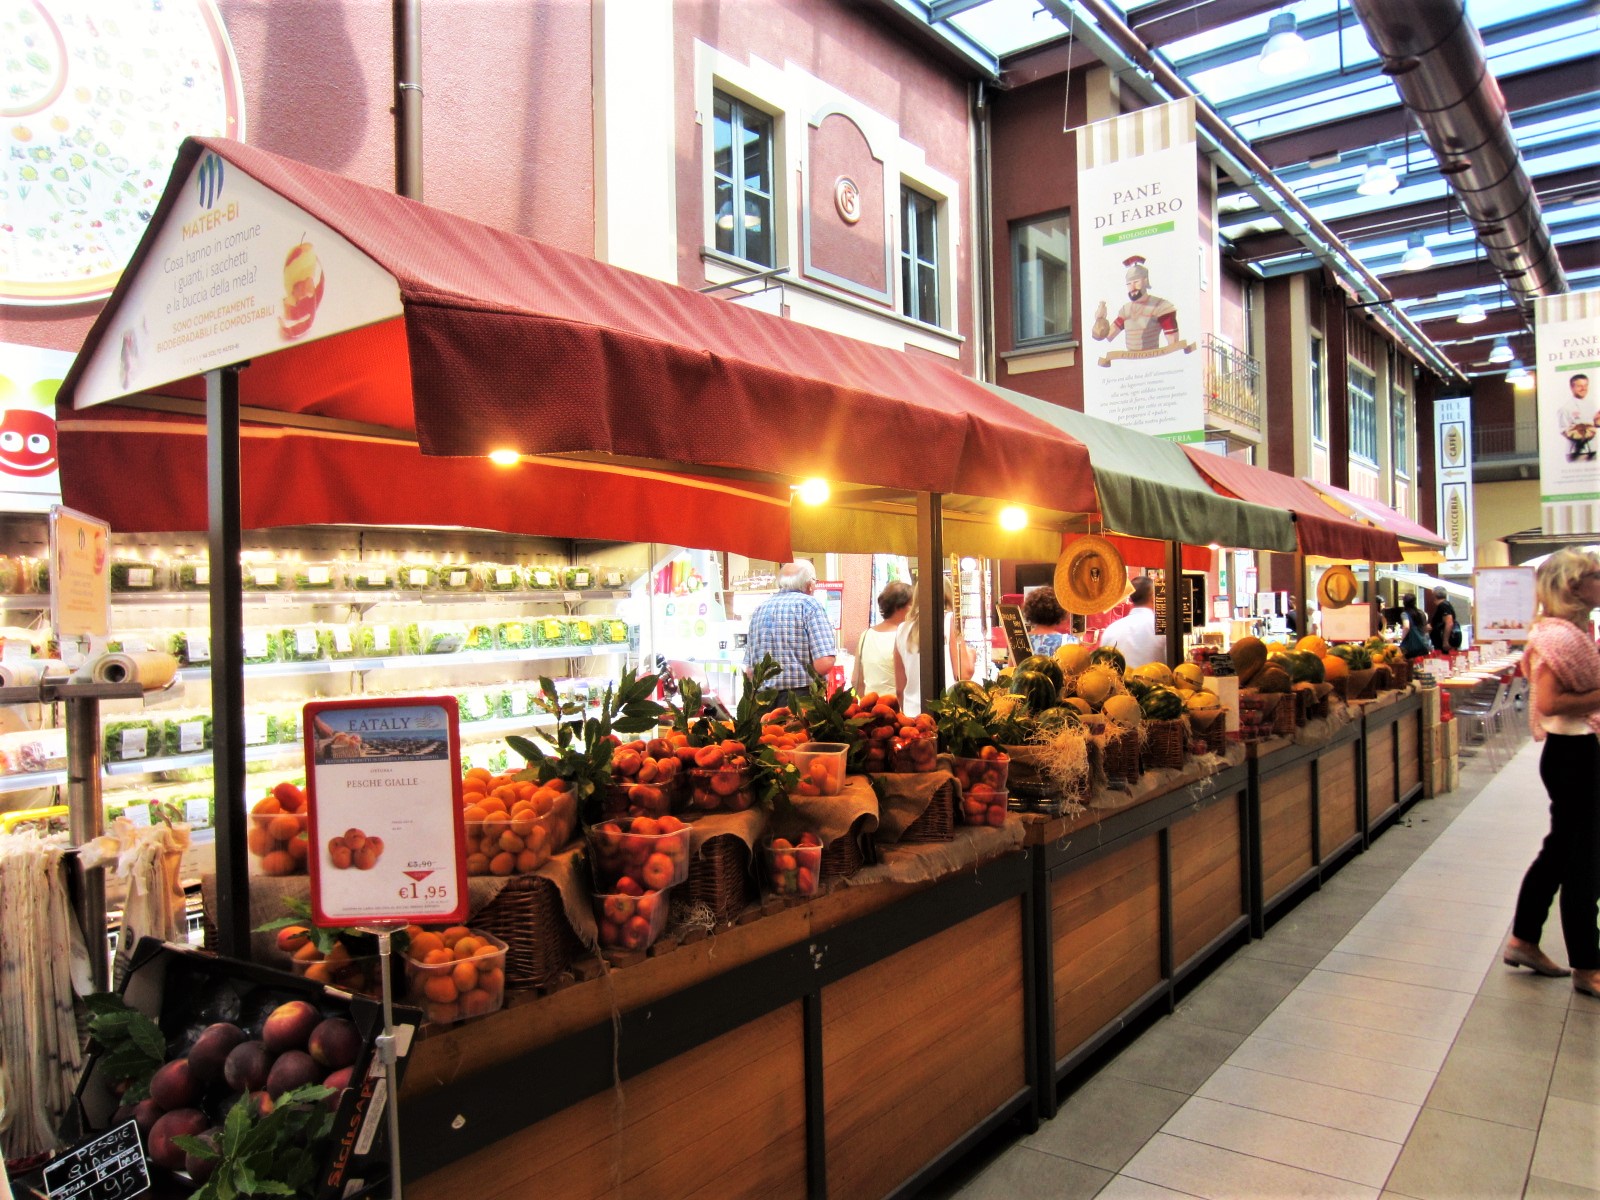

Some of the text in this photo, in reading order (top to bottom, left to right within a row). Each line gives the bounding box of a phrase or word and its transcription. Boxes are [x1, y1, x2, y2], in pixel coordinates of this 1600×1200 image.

[1113, 182, 1161, 205] PANE
[182, 202, 240, 241] MATER-BI
[1094, 198, 1183, 229] DI FARRO
[163, 224, 262, 274] Cosa hanno in comune
[1118, 227, 1158, 241] BIOLOGICO
[178, 269, 205, 294] guanti,
[211, 251, 249, 277] sacchetti
[166, 265, 258, 314] e la buccia della mela?
[156, 304, 276, 354] BIODEGRADABILI E COMPOSTABILI
[172, 296, 256, 334] SONO COMPLETAMENTE
[1548, 352, 1563, 361] DI
[1563, 335, 1600, 347] PANE
[1167, 434, 1192, 443] TERIA
[1451, 495, 1459, 547] PASTICCERIA
[349, 717, 411, 731] EATALY
[346, 777, 419, 788] PESCHE GIALLE
[398, 882, 447, 900] €1,95
[328, 1079, 374, 1187] SicilSAP
